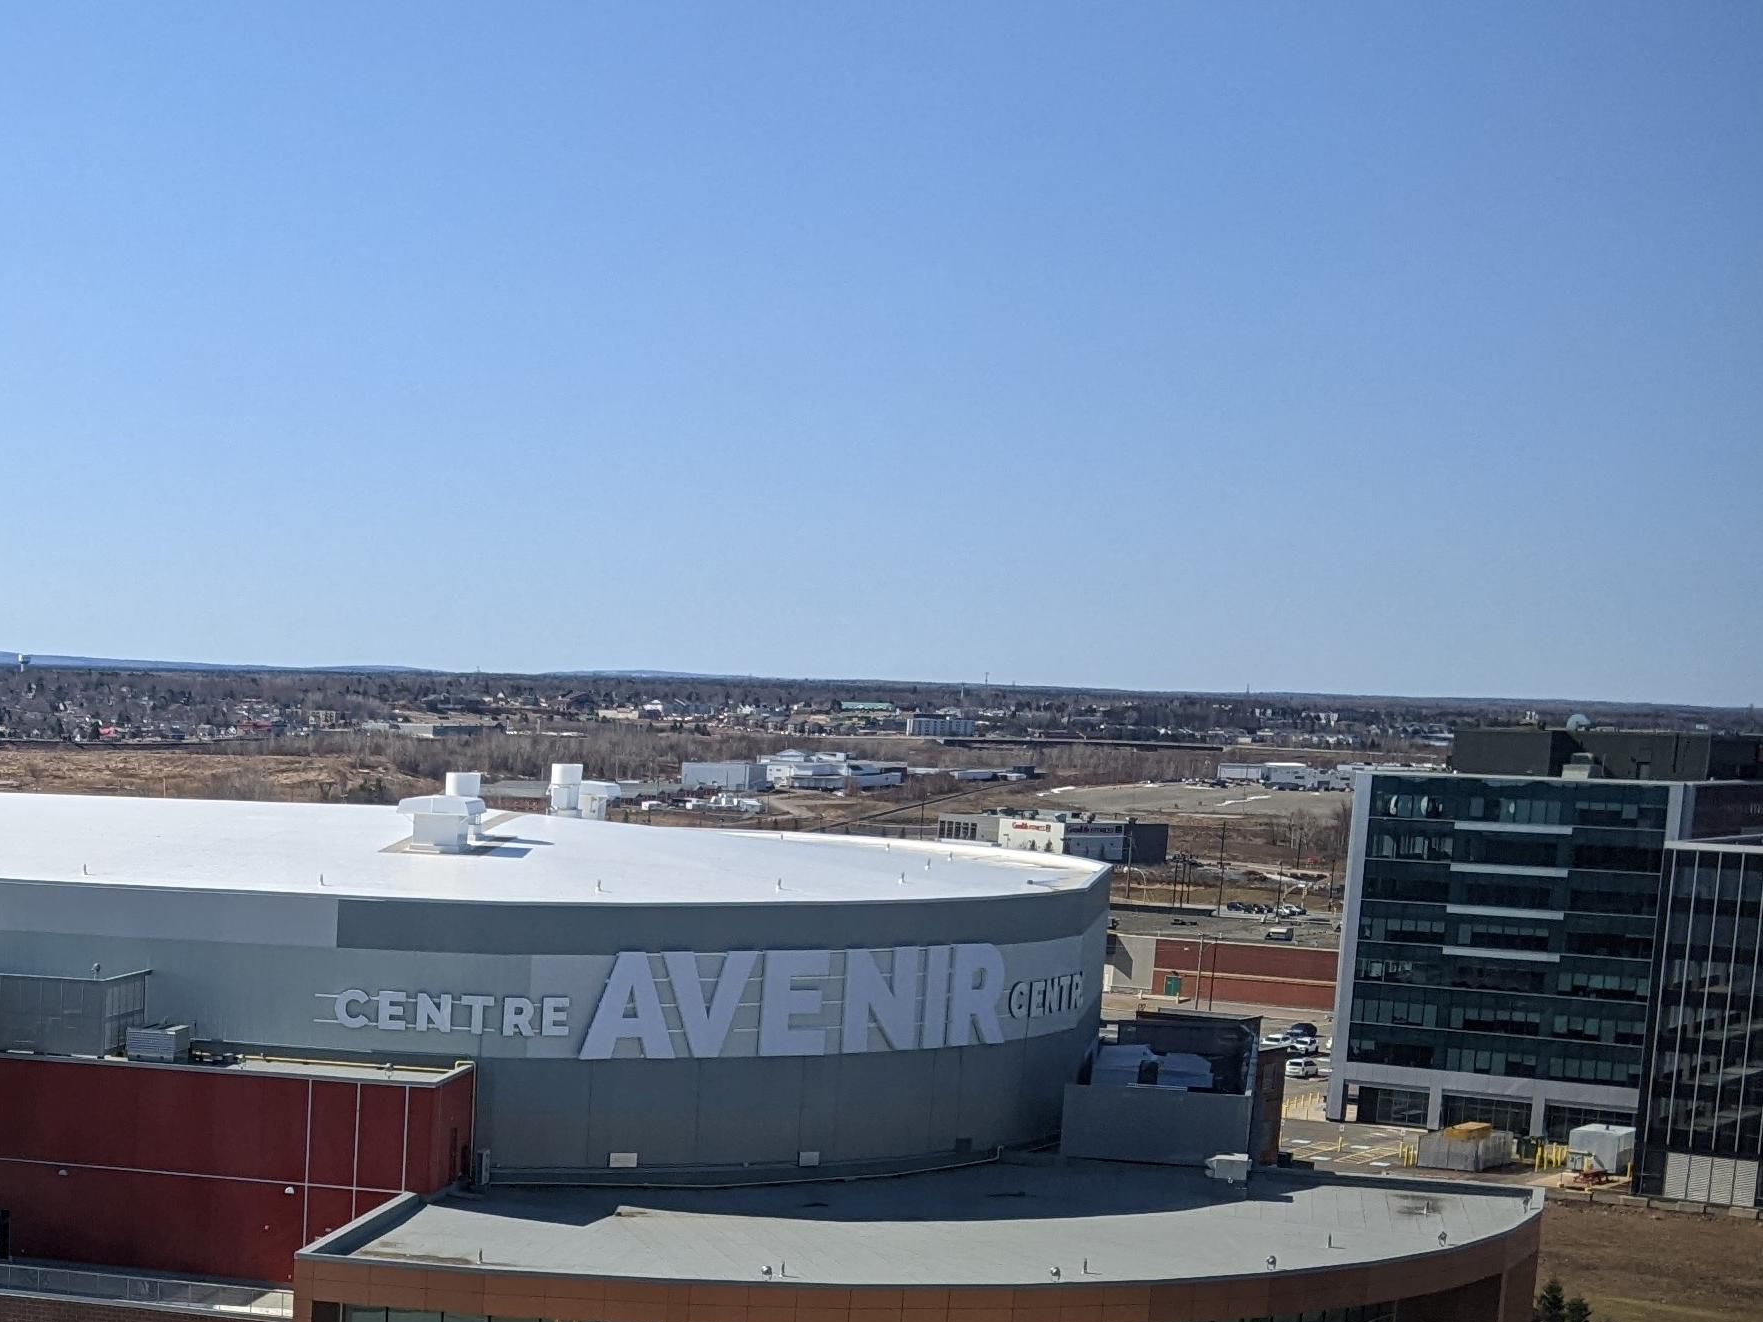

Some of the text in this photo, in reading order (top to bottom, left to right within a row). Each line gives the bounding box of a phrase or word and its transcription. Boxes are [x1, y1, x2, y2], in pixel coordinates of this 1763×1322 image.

[334, 943, 1083, 1060] CENTRE AVENIR CENTR
